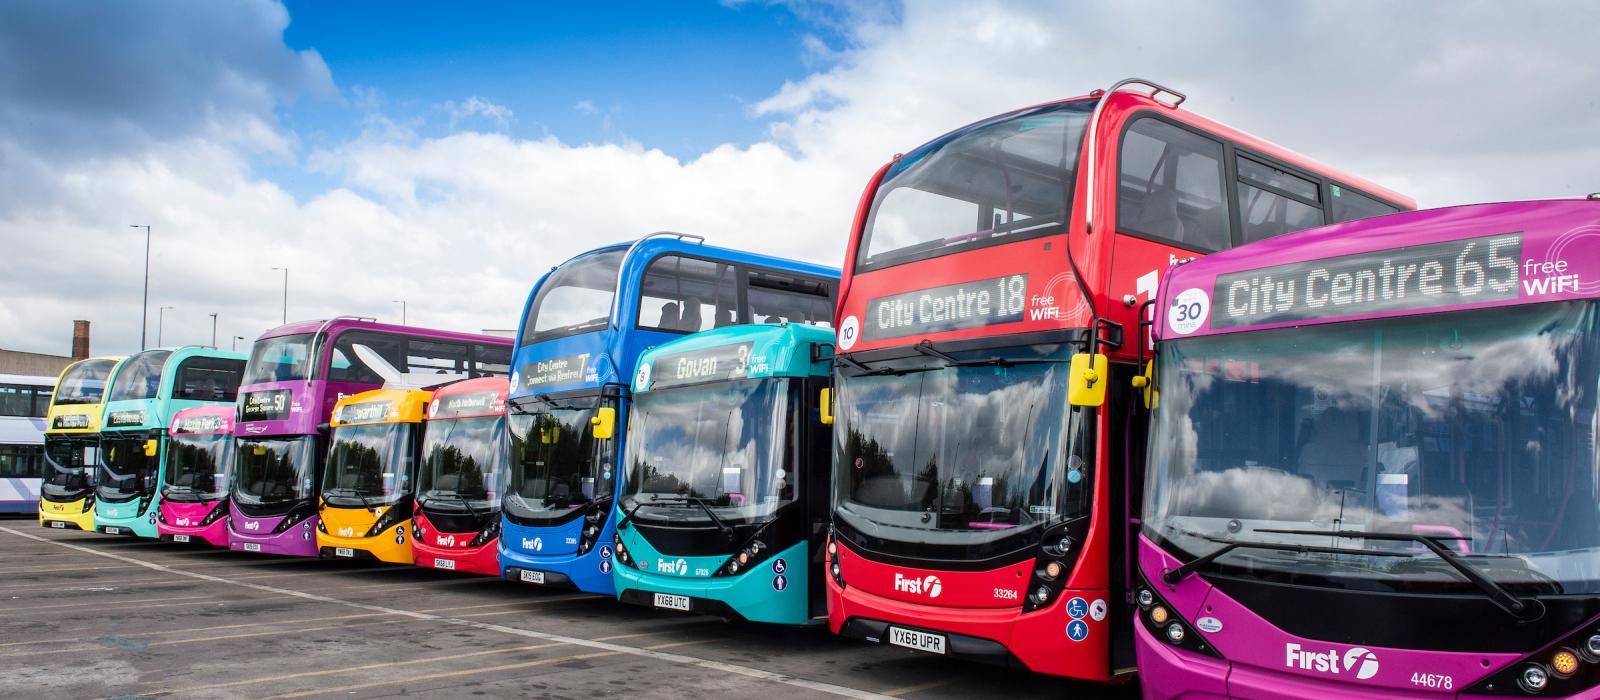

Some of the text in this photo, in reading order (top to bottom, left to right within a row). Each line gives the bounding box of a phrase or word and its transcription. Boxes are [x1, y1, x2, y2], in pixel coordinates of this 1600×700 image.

[1524, 258, 1567, 276] free
[1227, 236, 1520, 317] City Centre 65
[1524, 274, 1579, 296] WiFi
[878, 275, 1025, 330] City Centre 18
[1031, 294, 1055, 307] free
[1030, 306, 1059, 321] WiFi
[1176, 302, 1202, 322] 30
[843, 326, 854, 341] 10
[537, 359, 568, 374] City Centre
[751, 354, 767, 363] free
[677, 355, 718, 380] Govan
[750, 362, 769, 374] WiFi
[274, 394, 285, 411] 50
[522, 537, 534, 550] First
[657, 558, 675, 574] First
[894, 573, 922, 595] First
[657, 594, 687, 609] YX68 UTC
[993, 588, 1018, 600] 33264
[893, 629, 940, 650] YX68 UPR
[1286, 642, 1340, 674] First
[1410, 672, 1453, 690] 44678
